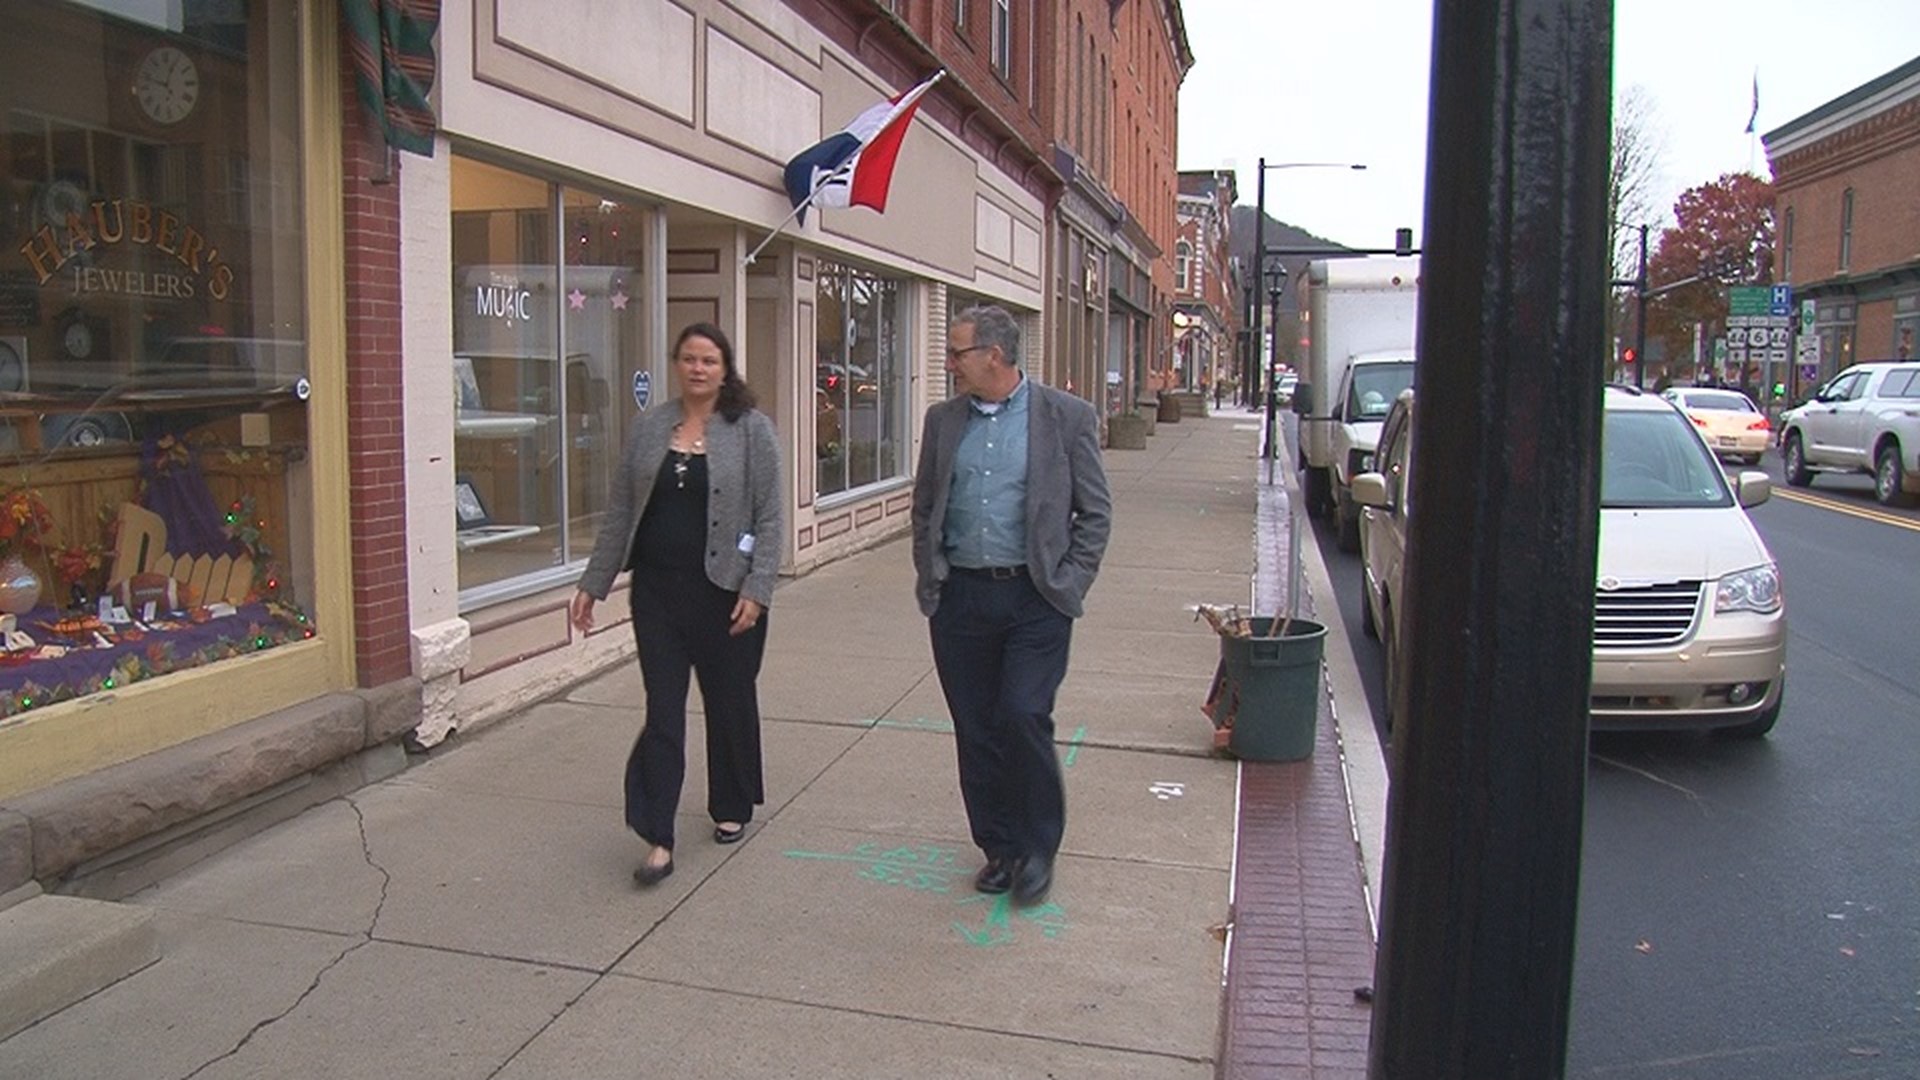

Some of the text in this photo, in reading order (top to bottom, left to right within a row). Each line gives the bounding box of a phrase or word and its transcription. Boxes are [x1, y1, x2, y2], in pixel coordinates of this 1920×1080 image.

[20, 199, 233, 300] HAUBER'S
[72, 266, 195, 298] JEWELERS
[1773, 287, 1787, 303] H
[1729, 332, 1745, 343] 44
[1754, 331, 1763, 343] 6
